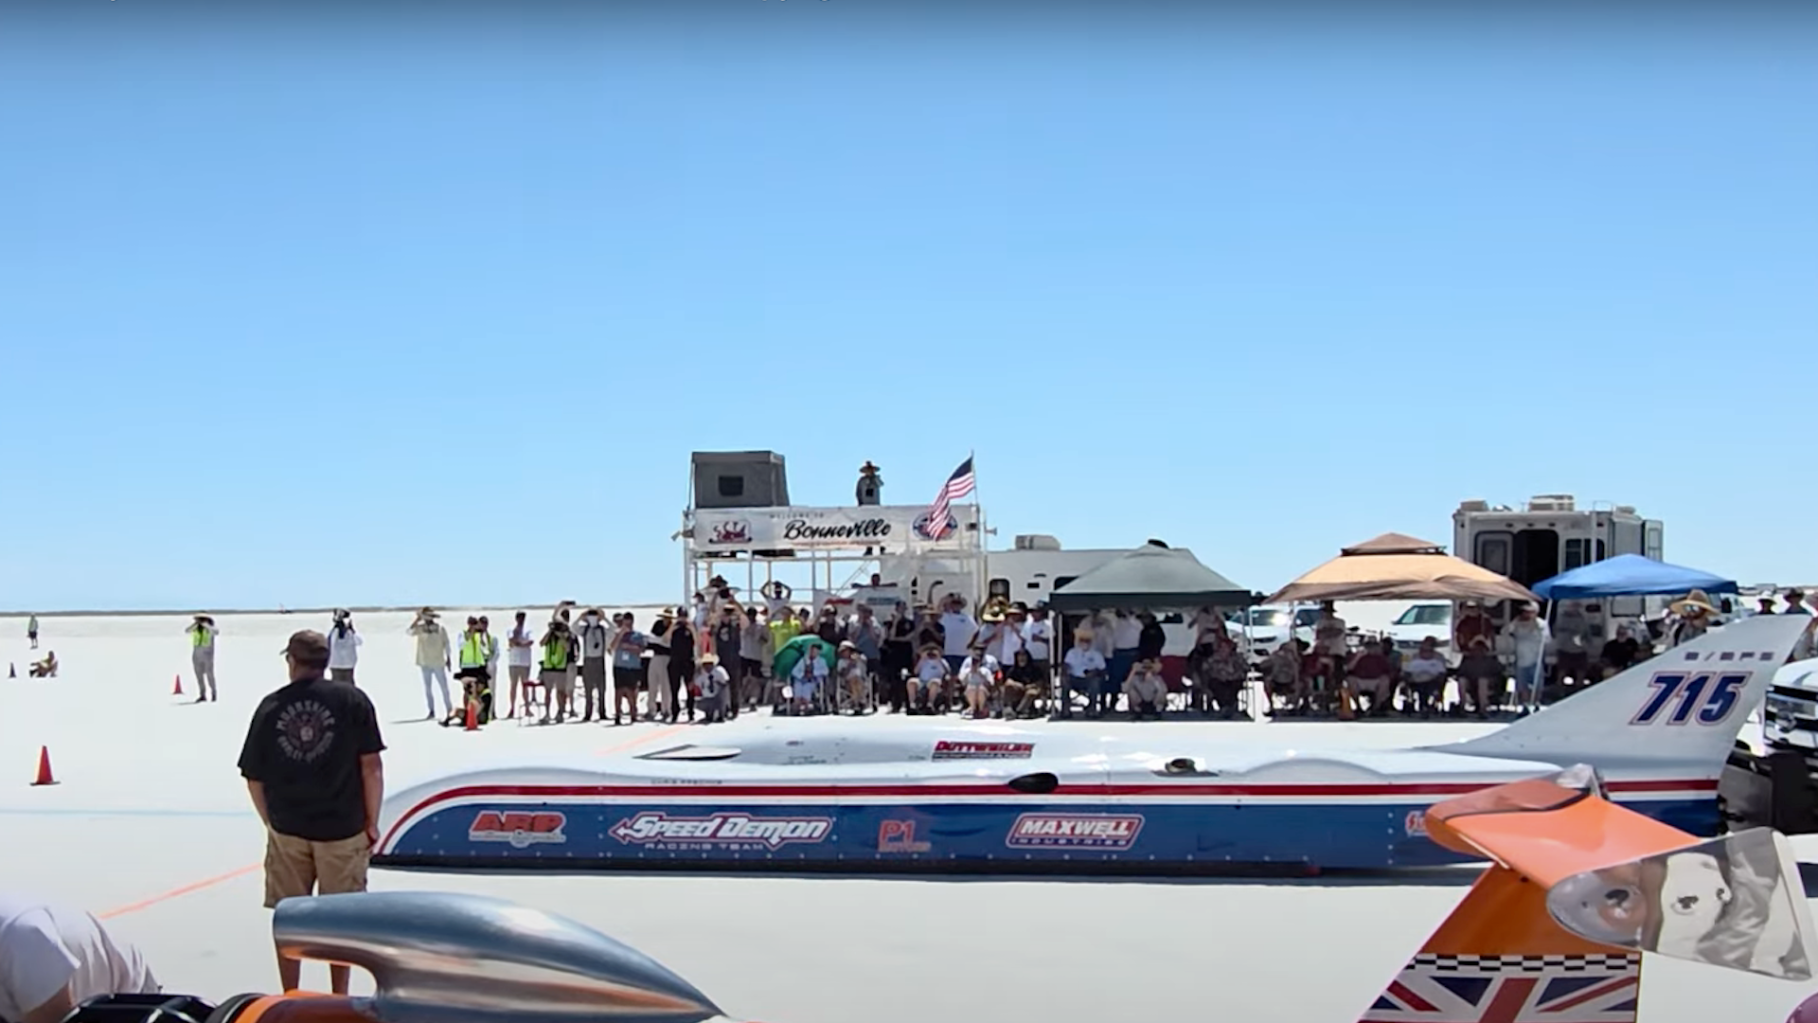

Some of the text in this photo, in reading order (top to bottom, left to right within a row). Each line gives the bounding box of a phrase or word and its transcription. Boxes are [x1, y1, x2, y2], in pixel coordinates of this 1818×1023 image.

[783, 518, 892, 540] Bonneville
[1629, 671, 1753, 726] 715
[471, 813, 564, 833] ARP
[1019, 819, 1130, 836] MAXWELL
